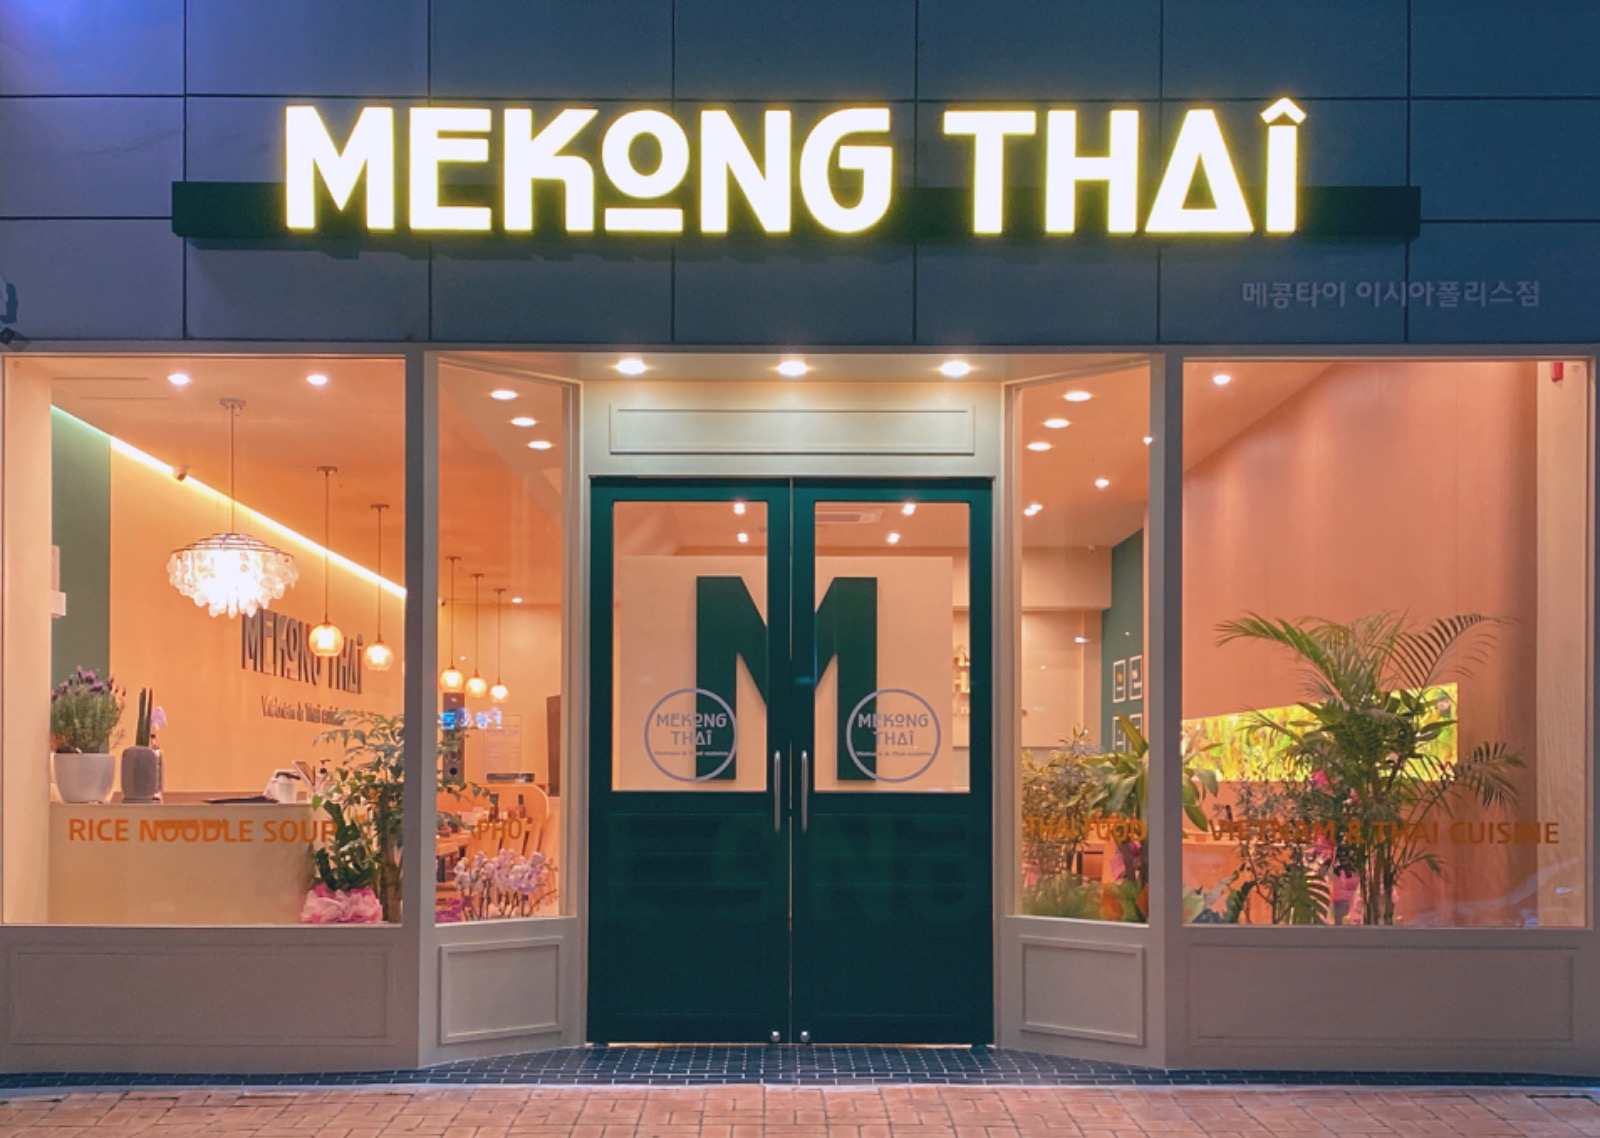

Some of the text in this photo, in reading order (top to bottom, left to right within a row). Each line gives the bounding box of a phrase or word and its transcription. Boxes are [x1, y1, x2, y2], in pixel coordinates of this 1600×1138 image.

[285, 104, 894, 234] MEKONG
[1241, 279, 1541, 309] 메콩타이 이시아폴리스점
[656, 712, 728, 728] MEKONG
[858, 712, 929, 728] MEKONG
[69, 818, 130, 842] RICE
[140, 818, 253, 843] NOODLE
[476, 818, 522, 841] PHO
[1208, 818, 1560, 845] VIETNAM & THAI CUISINE
